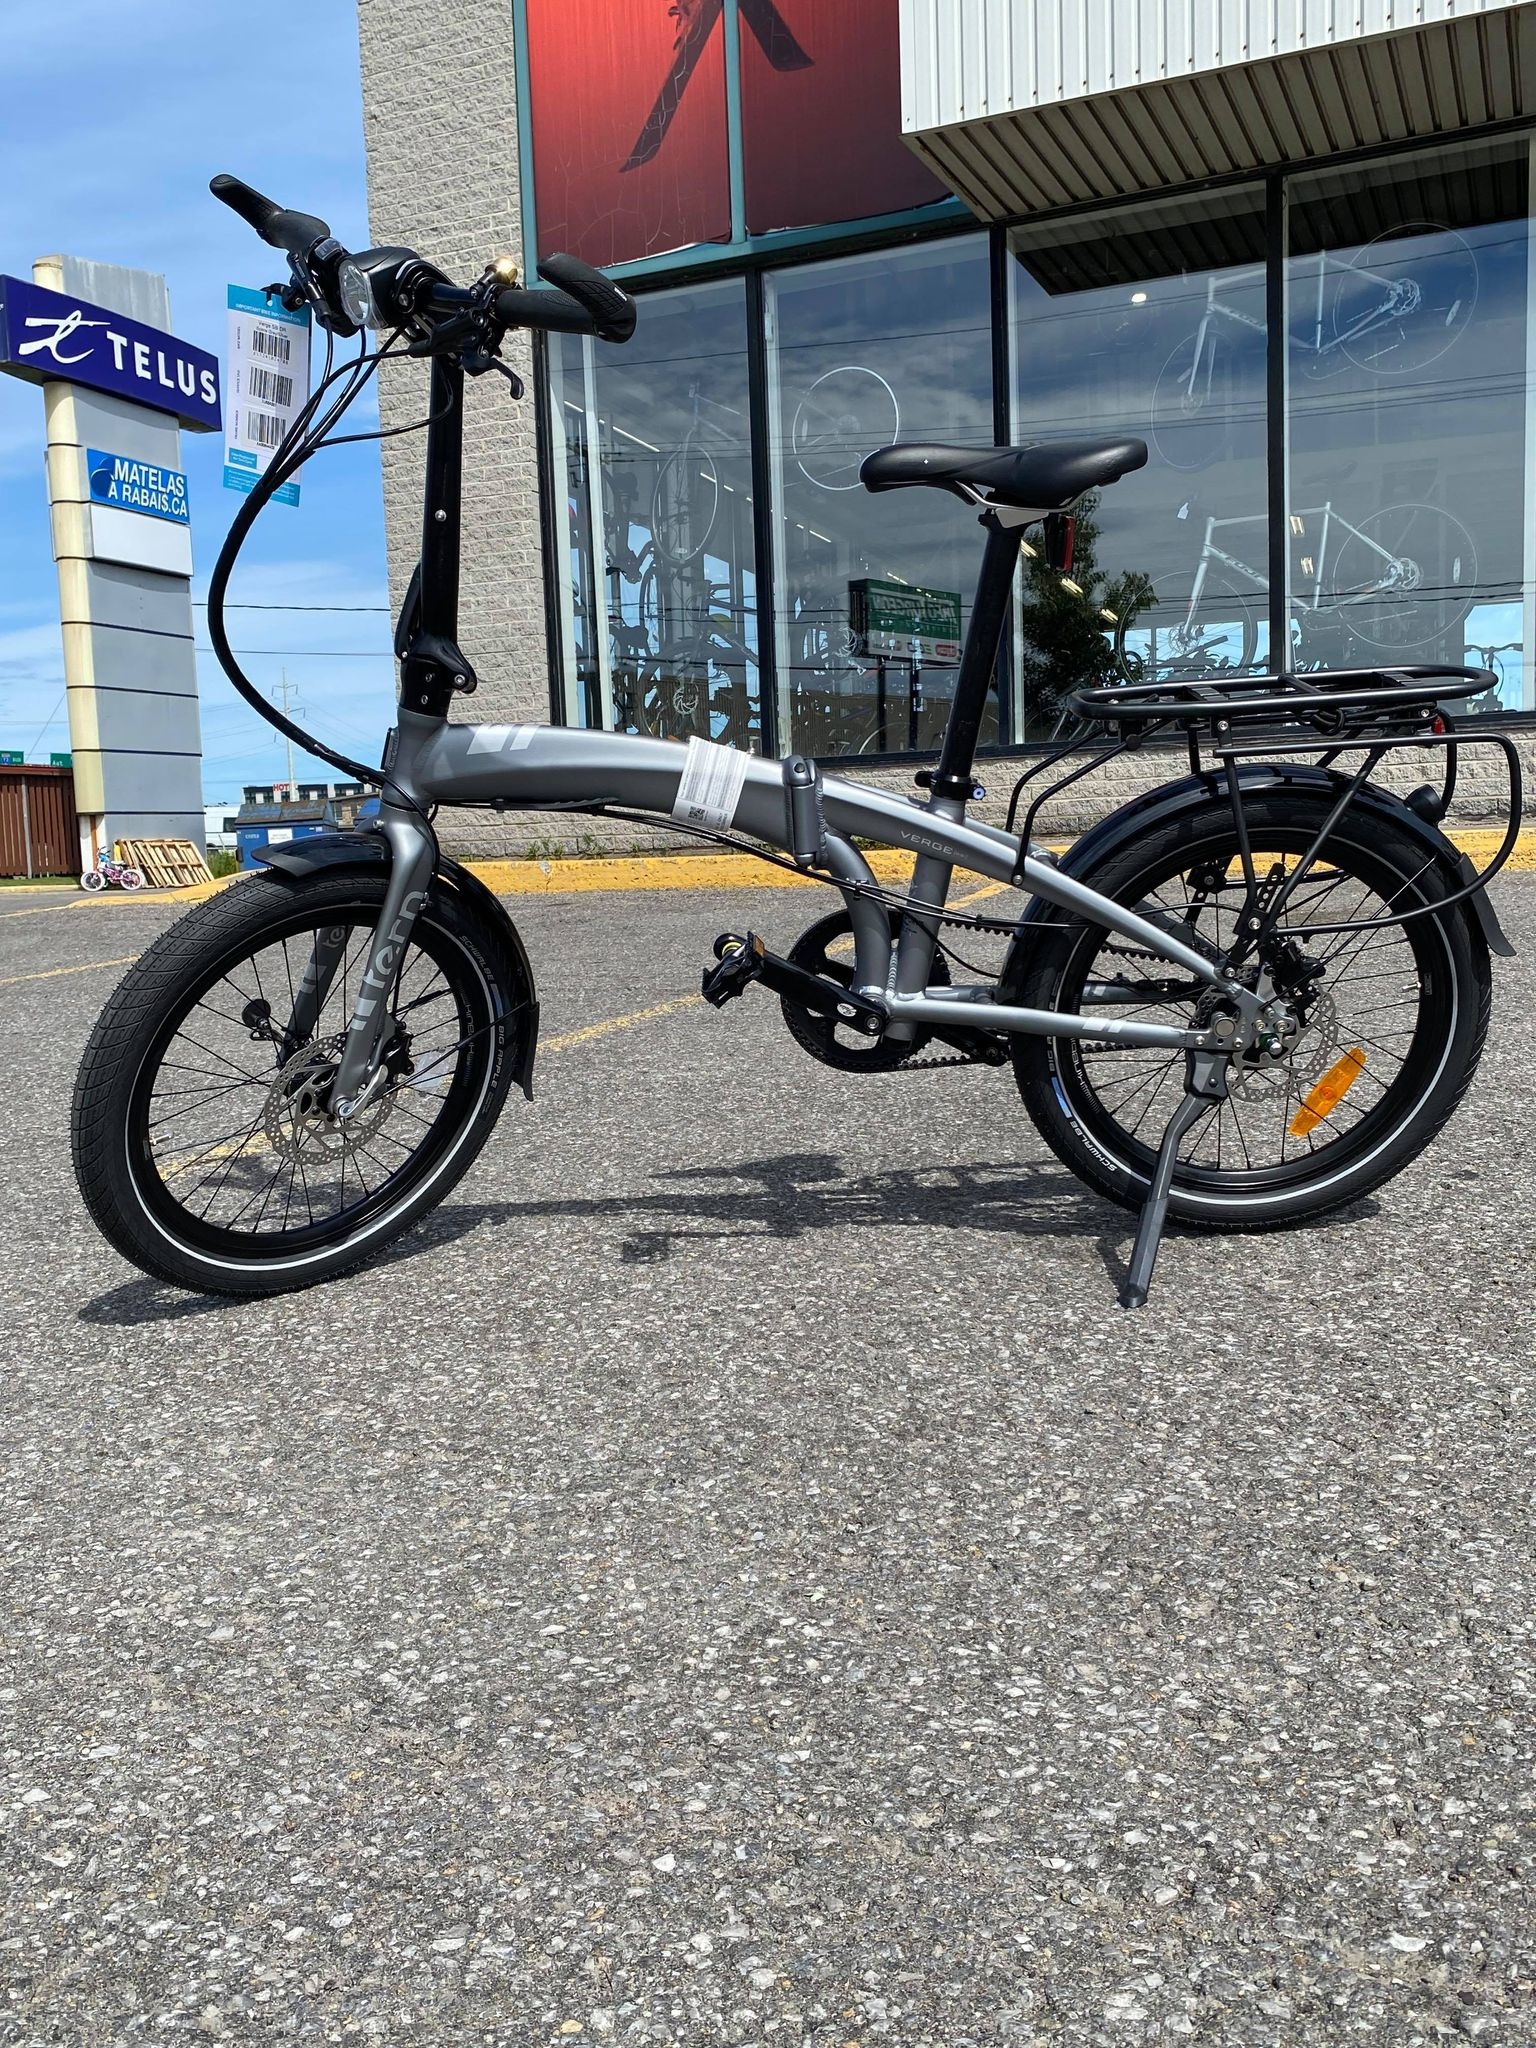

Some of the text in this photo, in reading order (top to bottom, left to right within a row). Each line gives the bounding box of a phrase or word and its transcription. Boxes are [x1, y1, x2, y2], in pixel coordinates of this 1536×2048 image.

[106, 330, 217, 405] TELUS
[107, 472, 118, 500] À
[114, 458, 184, 498] MATELAS
[900, 830, 953, 855] VERGE
[459, 935, 495, 981] SCHWALBE
[491, 1049, 504, 1089] APPLE
[1070, 1120, 1118, 1172] SCHWALBE
